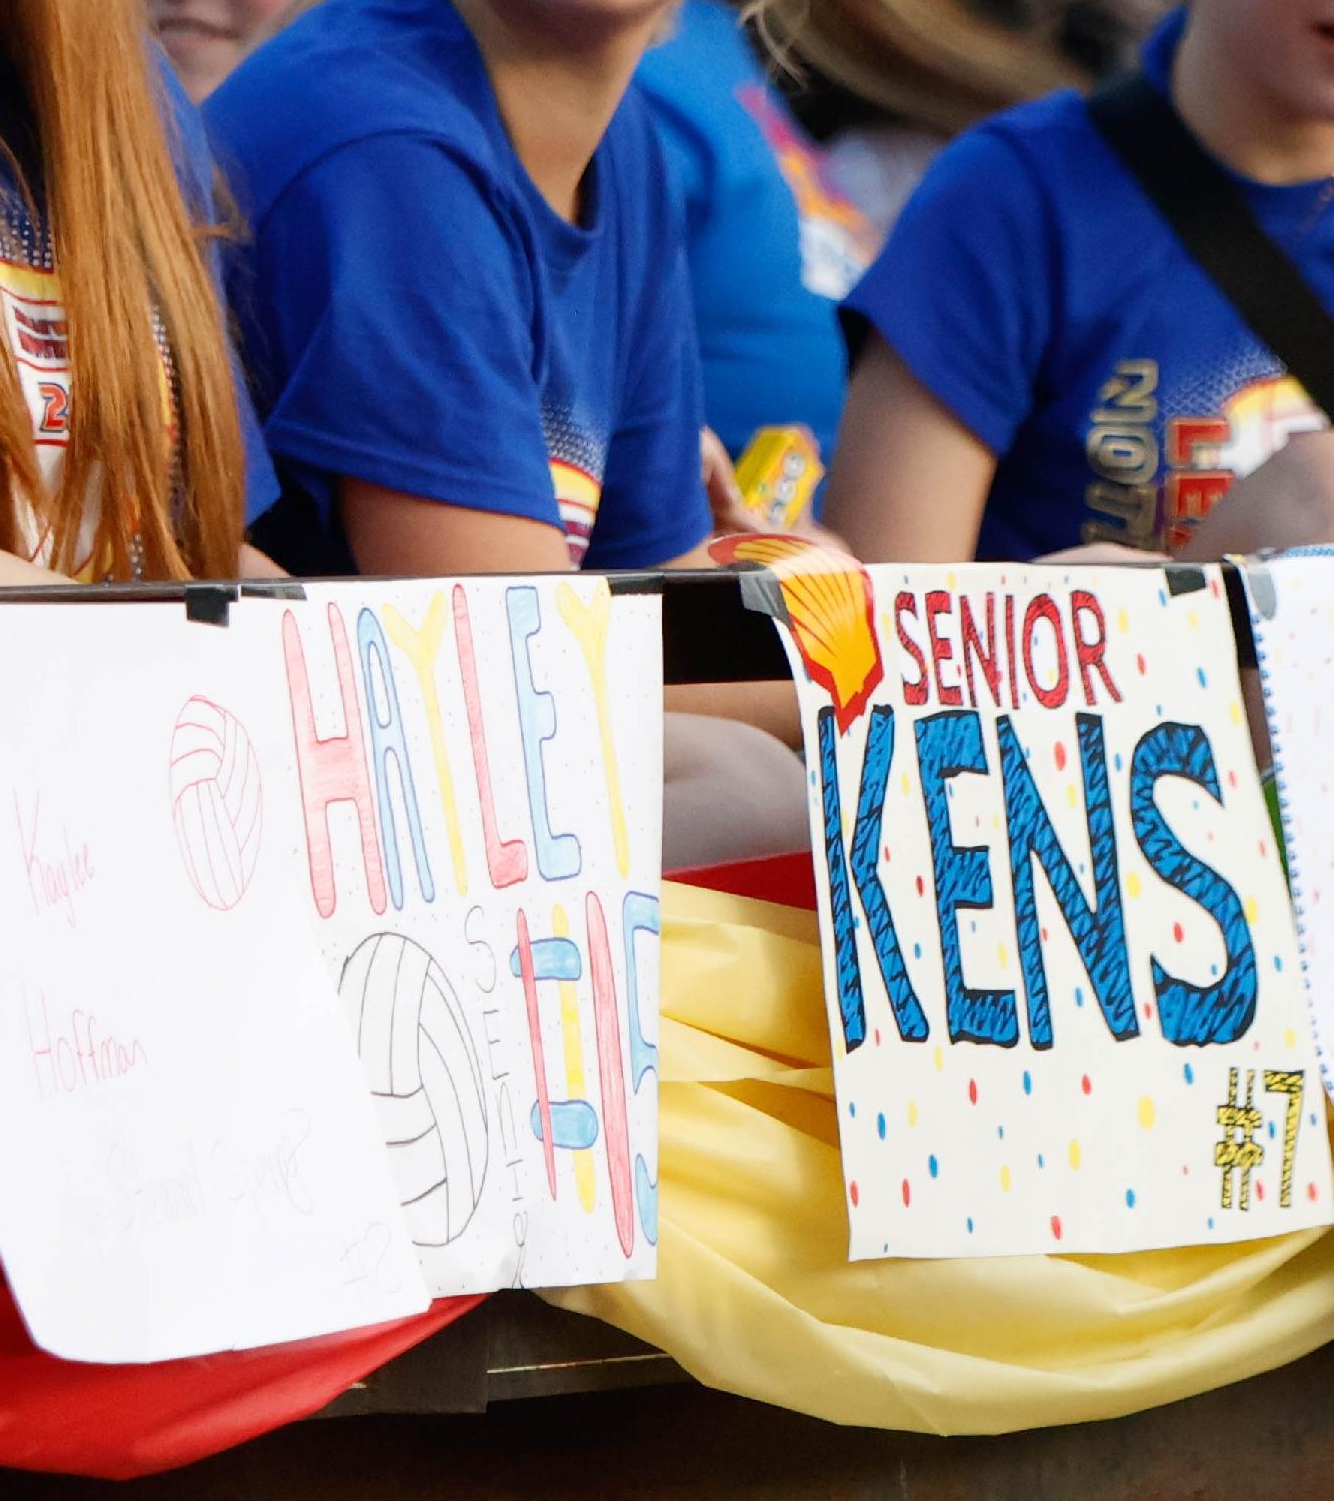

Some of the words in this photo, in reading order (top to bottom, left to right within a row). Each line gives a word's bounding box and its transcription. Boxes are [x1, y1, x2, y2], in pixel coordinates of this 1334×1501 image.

[893, 589, 1123, 710] SENIOR
[282, 576, 630, 918] HAYLEY
[817, 703, 1258, 1054] KENS
[20, 978, 148, 1103] Hoffman
[1214, 1065, 1305, 1211] #7
